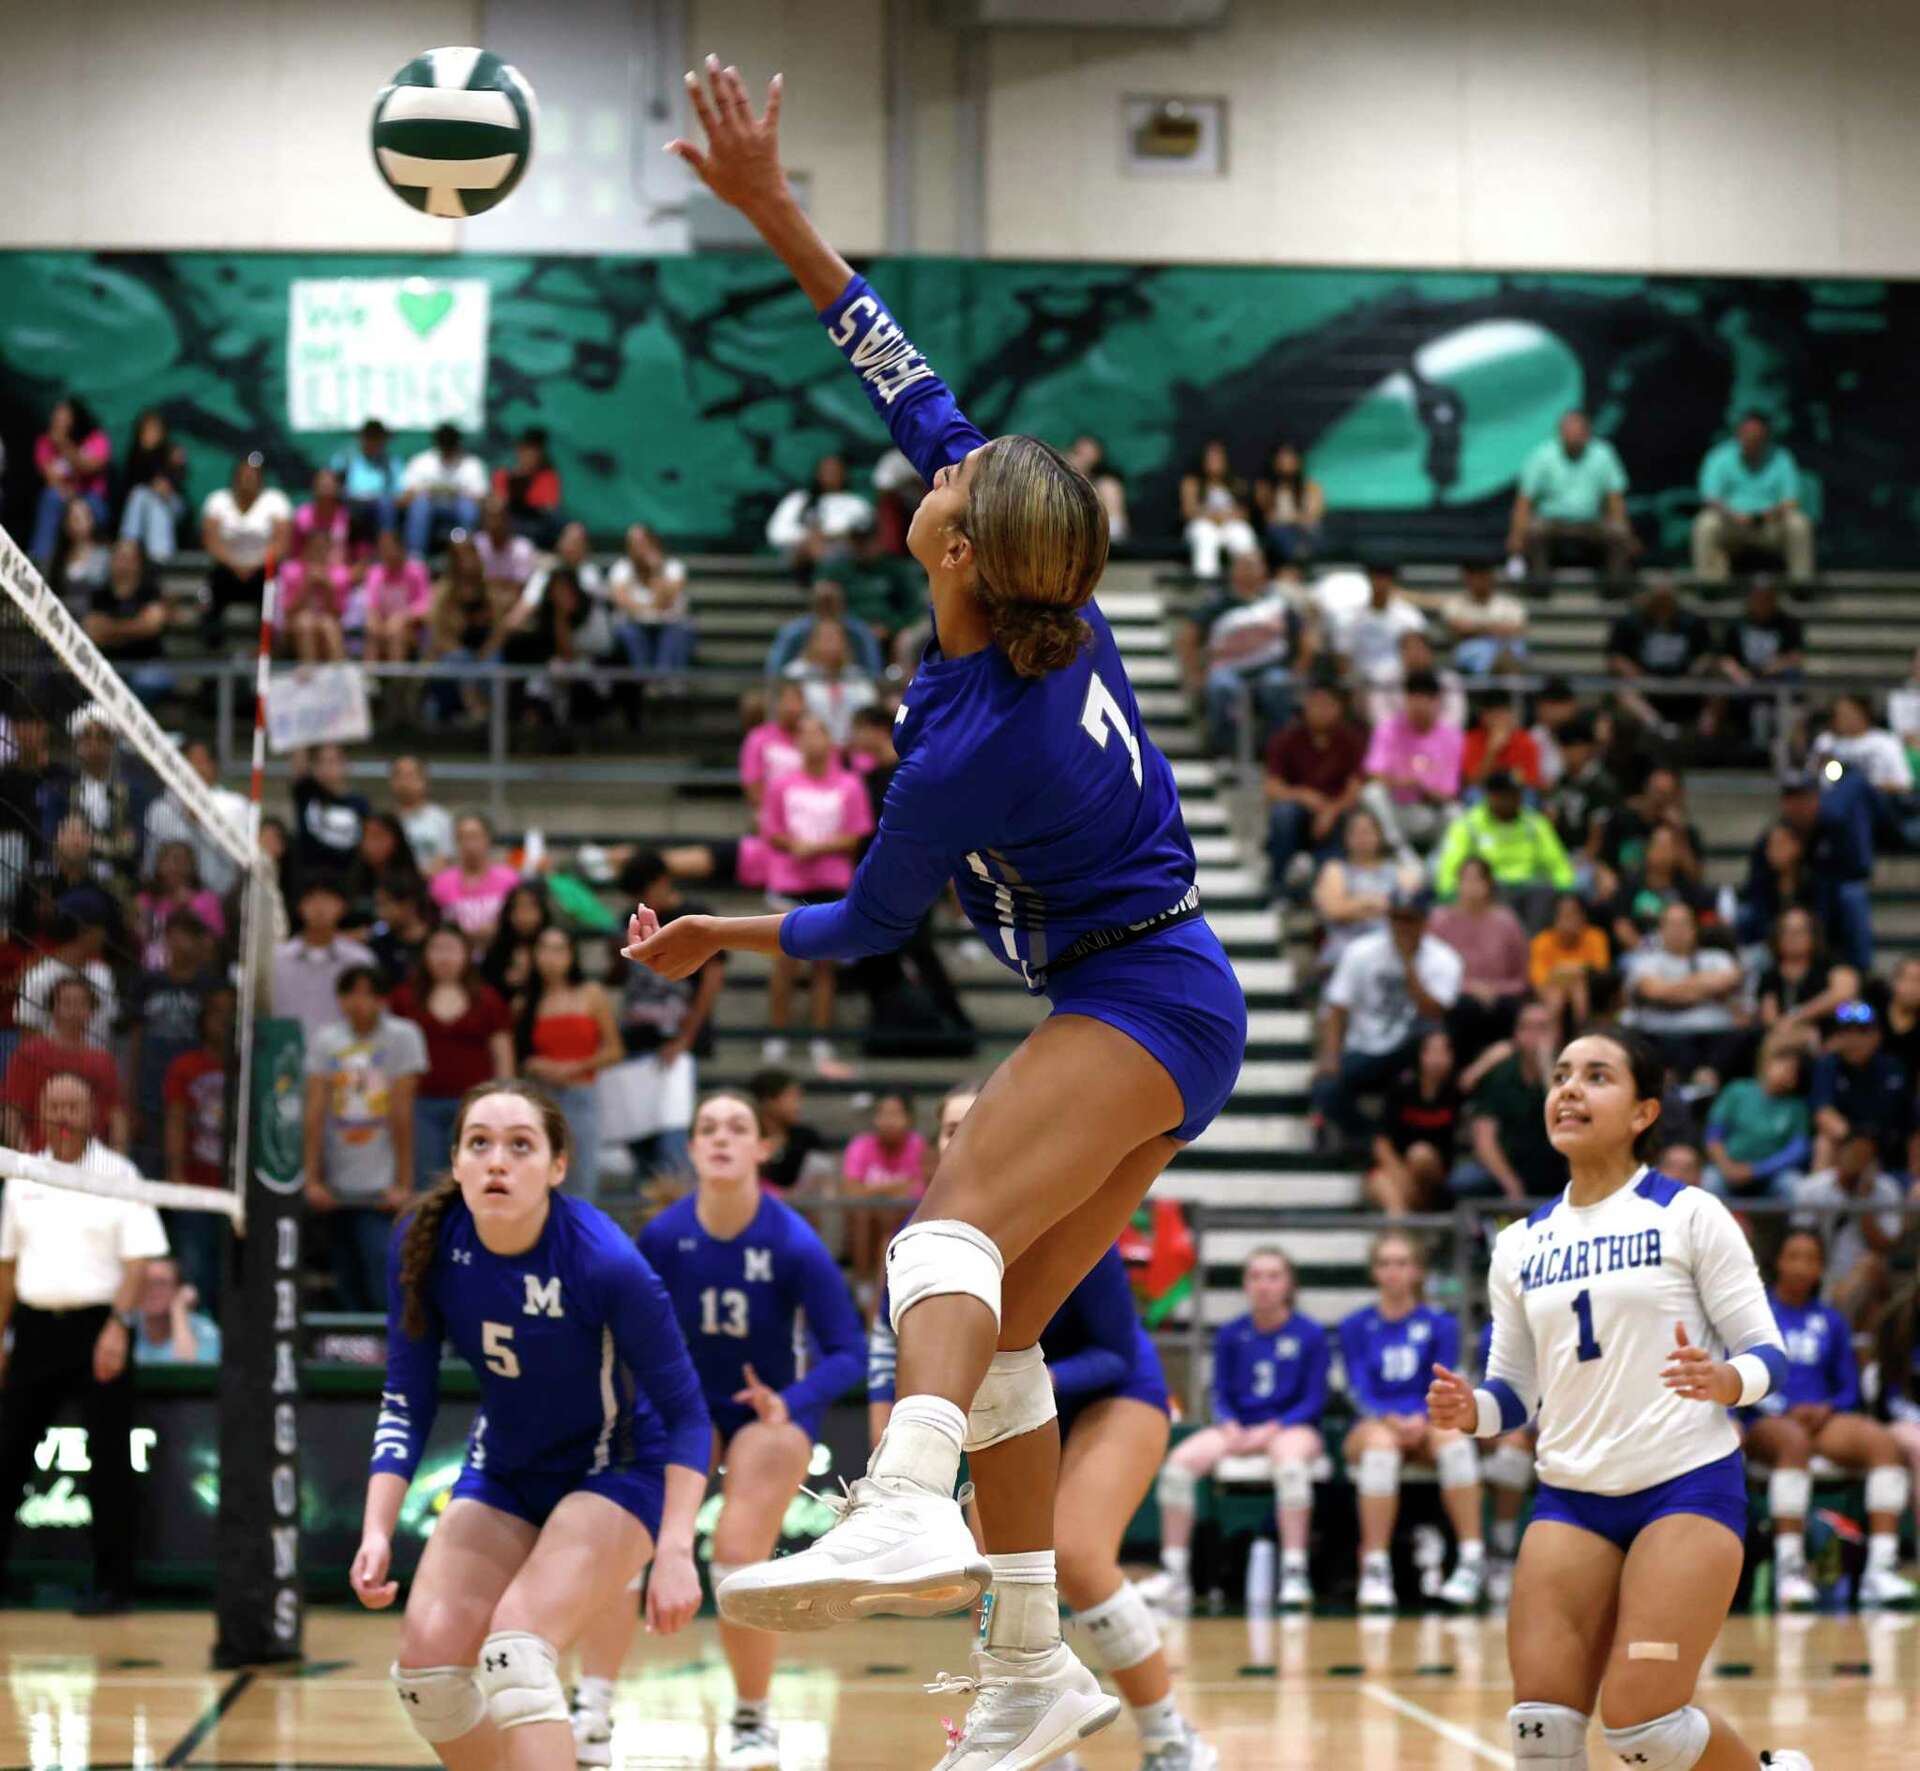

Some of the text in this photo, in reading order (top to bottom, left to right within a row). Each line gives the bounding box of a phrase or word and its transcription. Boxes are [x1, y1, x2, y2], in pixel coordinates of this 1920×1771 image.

[1080, 671, 1144, 792] 7
[744, 1249, 774, 1283] M
[1520, 1229, 1663, 1292] MACARTHUR
[523, 1274, 564, 1318] M
[700, 1288, 748, 1339] 13
[1570, 1289, 1602, 1362] 1
[482, 1320, 520, 1379] 5
[1252, 1360, 1275, 1399] 3
[272, 1217, 299, 1640] DRAGONS
